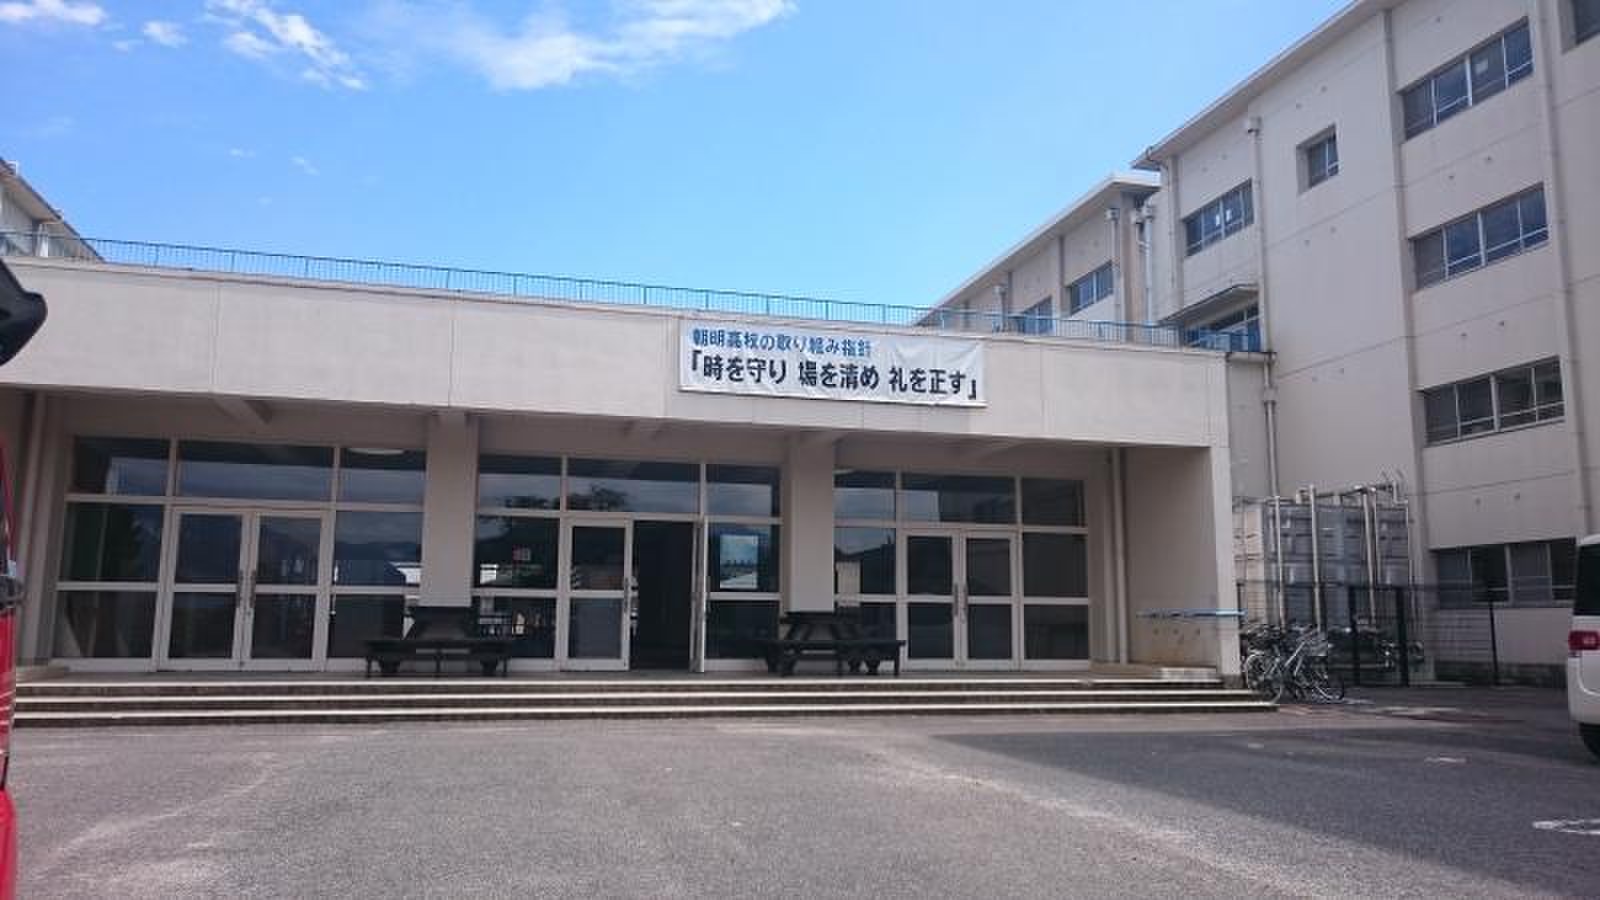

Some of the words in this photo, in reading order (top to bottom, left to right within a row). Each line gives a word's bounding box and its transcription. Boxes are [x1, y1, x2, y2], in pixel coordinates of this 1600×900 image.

[692, 350, 786, 384] 「時を守り
[798, 360, 879, 390] 場を清め
[888, 365, 977, 400] 礼を正す」
